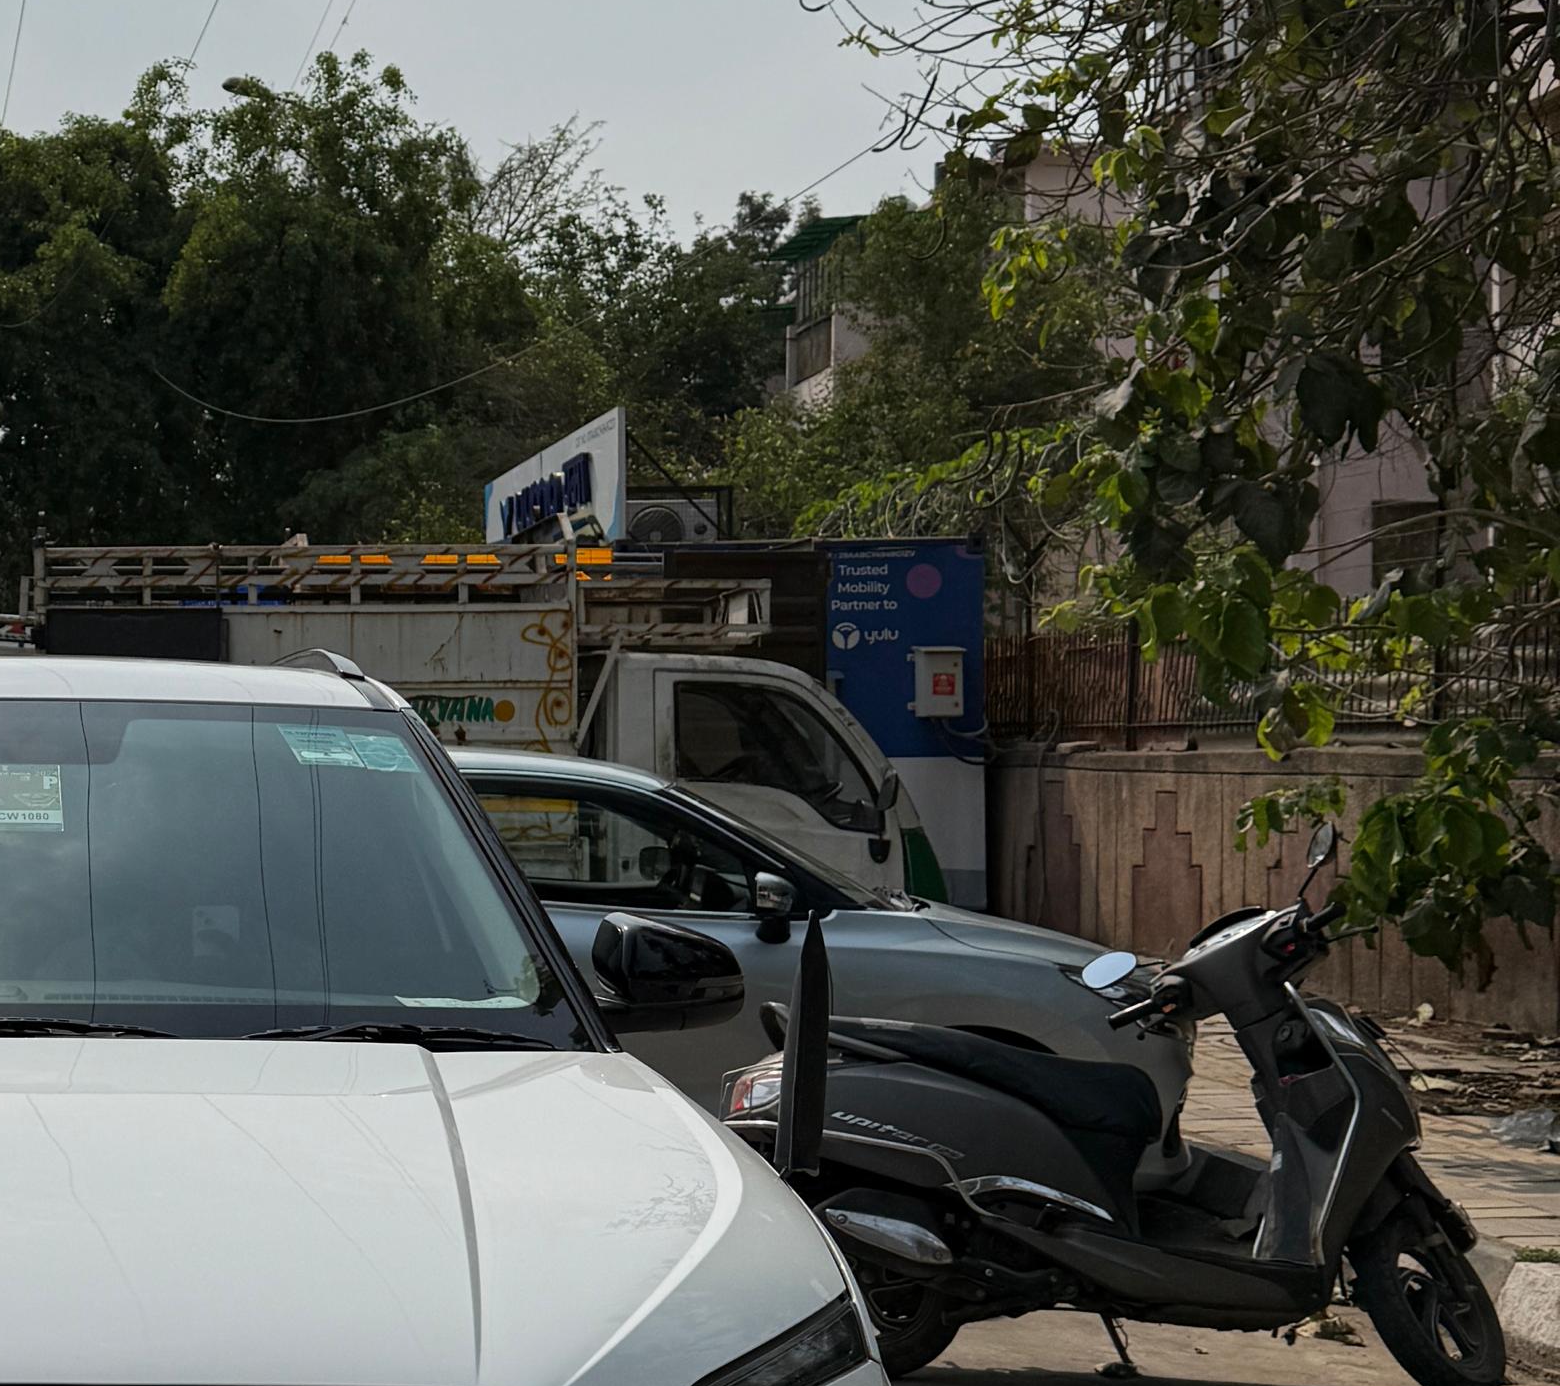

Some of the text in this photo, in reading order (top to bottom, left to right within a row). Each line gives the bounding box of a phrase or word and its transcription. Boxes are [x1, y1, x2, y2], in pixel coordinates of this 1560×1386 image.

[838, 564, 888, 576] Trusted
[838, 581, 890, 596] Mobility
[831, 600, 898, 612] Partner to
[864, 627, 899, 644] yulu
[43, 776, 58, 790] P
